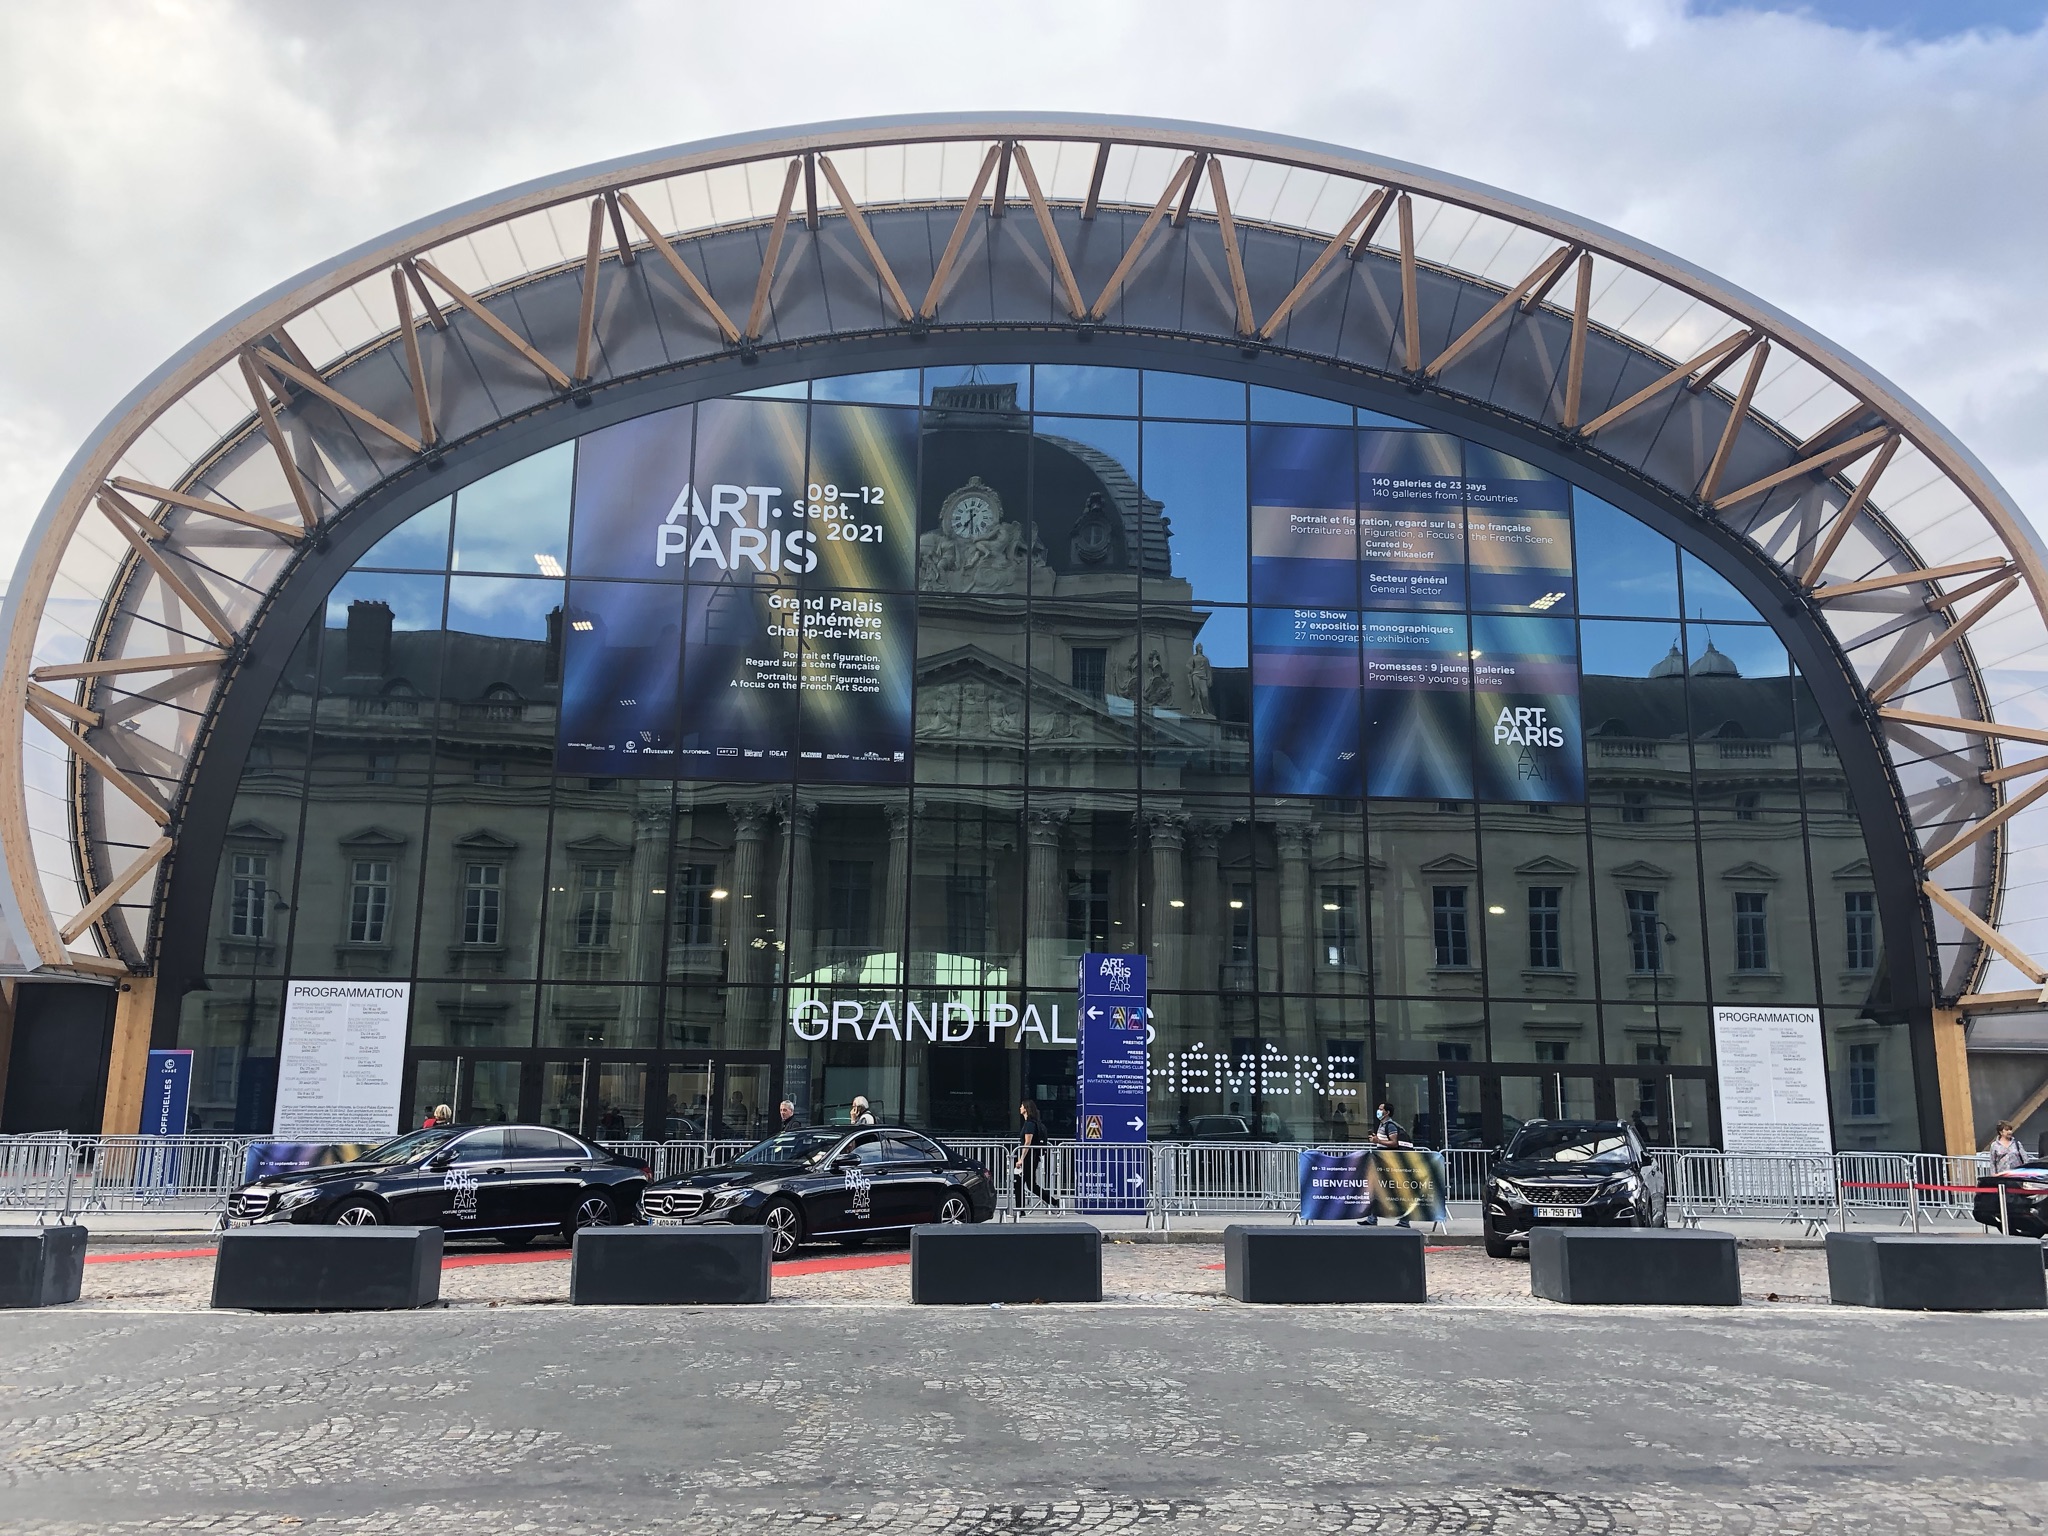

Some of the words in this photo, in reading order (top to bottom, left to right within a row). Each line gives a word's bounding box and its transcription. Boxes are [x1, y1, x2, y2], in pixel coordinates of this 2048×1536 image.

[1372, 478, 1390, 486] 140
[1393, 479, 1431, 490] galeries
[1435, 481, 1447, 489] de
[1450, 482, 1462, 490] 23
[1372, 489, 1389, 497] 140
[1392, 490, 1432, 500] galleries
[1435, 491, 1456, 499] from
[1474, 493, 1518, 503] countries
[1291, 514, 1327, 524] Portrait
[1330, 516, 1339, 524] et
[1343, 516, 1392, 528] figration,
[1395, 519, 1427, 529] regard
[1447, 520, 1456, 528] la
[1488, 523, 1531, 533] française
[826, 523, 883, 543] 2021
[1291, 525, 1347, 535] Portraiture
[1364, 528, 1415, 539] Figuration,
[1427, 531, 1454, 539] Focus
[1472, 533, 1487, 542] the
[1490, 534, 1522, 543] French
[1525, 535, 1553, 545] Scene
[656, 524, 818, 574] PARIS
[1366, 540, 1399, 549] Curated
[1403, 541, 1413, 550] by
[1366, 549, 1391, 558] Hervé
[1394, 550, 1434, 559] Mikaeloff
[1370, 574, 1407, 584] Secteur
[1411, 574, 1448, 586] général
[1370, 584, 1407, 594] General
[1411, 586, 1441, 595] Sector
[769, 595, 823, 611] Grand
[831, 597, 883, 613] Palais
[1295, 610, 1317, 619] Solo
[1320, 611, 1347, 620] Show
[1295, 621, 1306, 629] 27
[1370, 624, 1454, 635] monographiques
[1377, 634, 1429, 645] exhibitions
[783, 651, 818, 660] Porrait
[833, 653, 880, 663] figuration.
[746, 658, 779, 668] Regard
[810, 660, 836, 669] scène
[839, 662, 880, 671] française
[1369, 662, 1422, 672] Promesses
[1431, 663, 1437, 672] 9
[1476, 666, 1515, 675] galeries
[757, 672, 806, 682] Portraitue
[830, 675, 880, 685] Figuration.
[1369, 673, 1416, 682] Promises:
[1428, 675, 1459, 685] young
[730, 679, 737, 687] A
[740, 680, 765, 688] focus
[801, 683, 831, 691] French
[835, 683, 849, 692] Art
[852, 684, 880, 693] Scene
[1494, 726, 1564, 747] PARIS
[1100, 967, 1131, 976] PARIS
[1110, 975, 1129, 984] ART
[294, 986, 403, 998] PROGRAMMATION
[1110, 983, 1130, 992] FAIR
[792, 1000, 975, 1042] GRAND
[1719, 1012, 1814, 1023] PROGRAMMATION
[160, 1079, 172, 1134] OFFICIELLES
[444, 1178, 478, 1190] PARIS
[845, 1178, 870, 1190] PARIS
[1312, 1179, 1368, 1188] BIENVENUE
[1378, 1180, 1433, 1189] WELCOME
[455, 1189, 477, 1199] ART
[854, 1189, 869, 1199] ART
[453, 1198, 477, 1209] FAIR
[853, 1198, 870, 1208] FAIR
